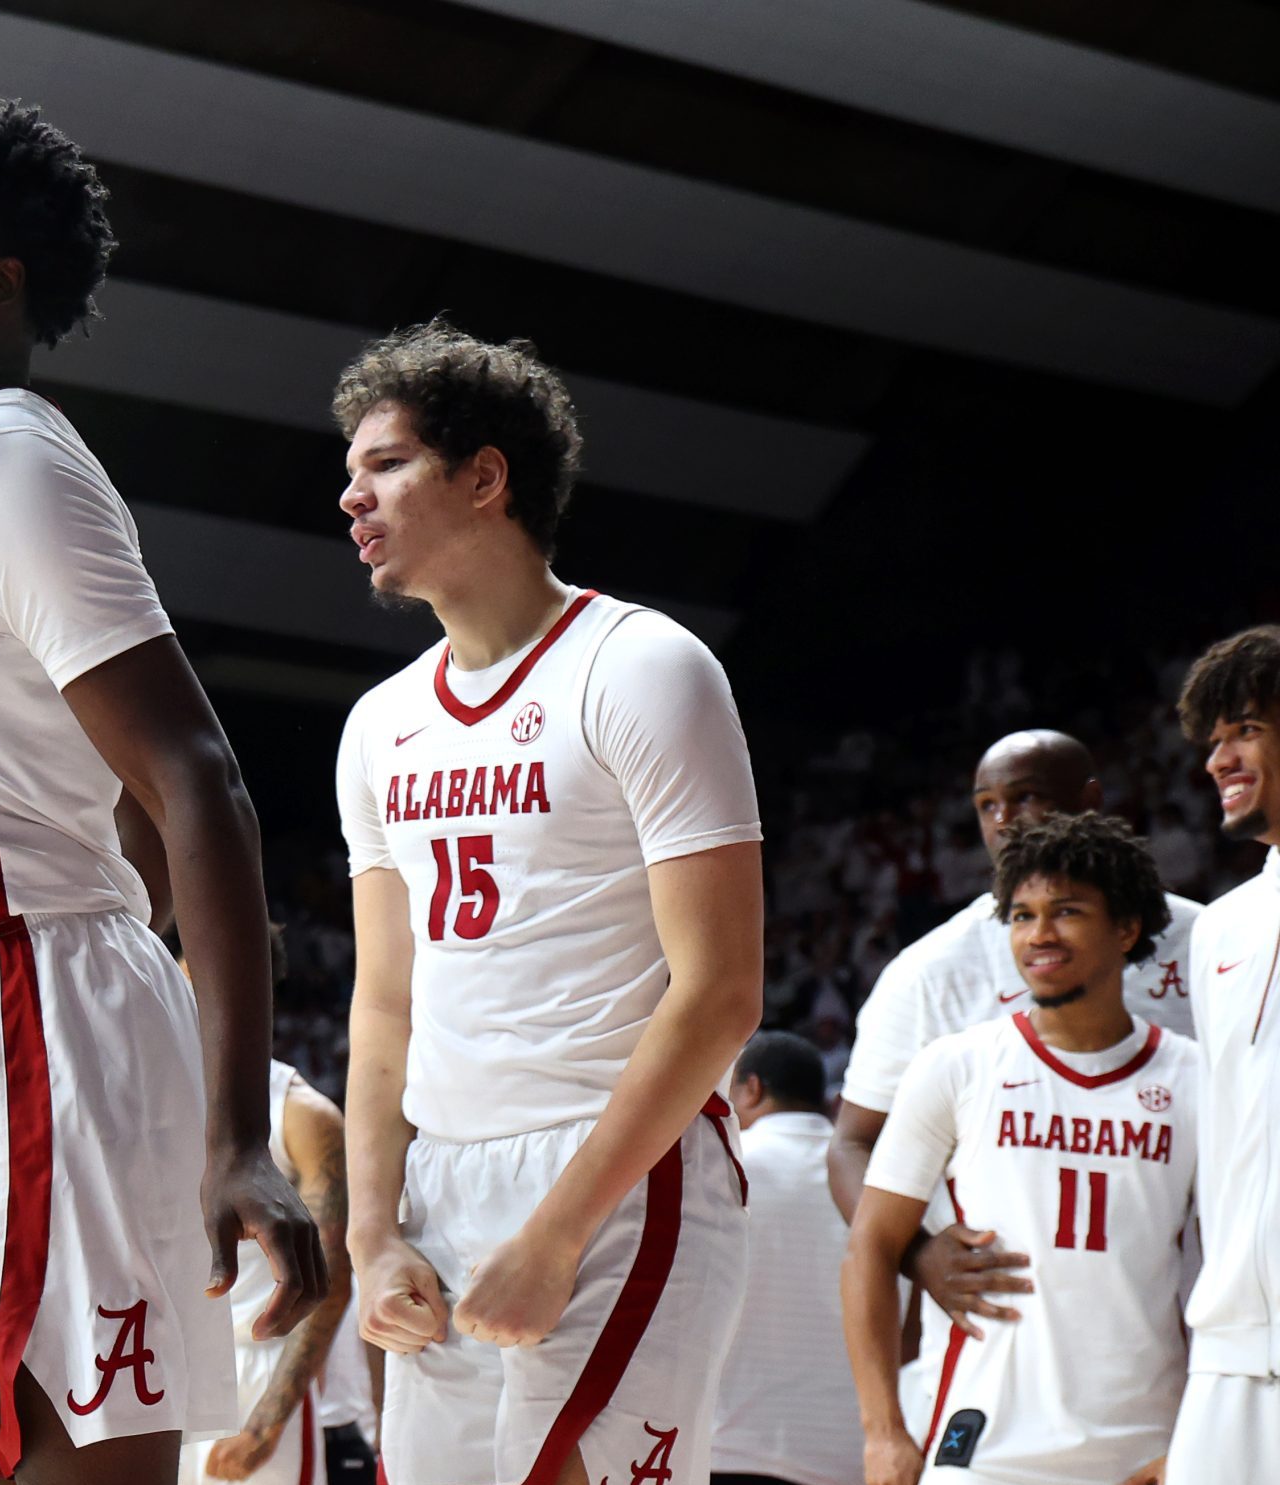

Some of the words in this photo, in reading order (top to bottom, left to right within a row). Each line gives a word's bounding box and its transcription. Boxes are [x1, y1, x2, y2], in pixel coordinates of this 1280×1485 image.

[386, 761, 551, 824] ALABAMA
[428, 834, 500, 941] 15
[997, 1110, 1173, 1165] ALABAMA
[1054, 1167, 1108, 1252] 11
[67, 1298, 165, 1416] A
